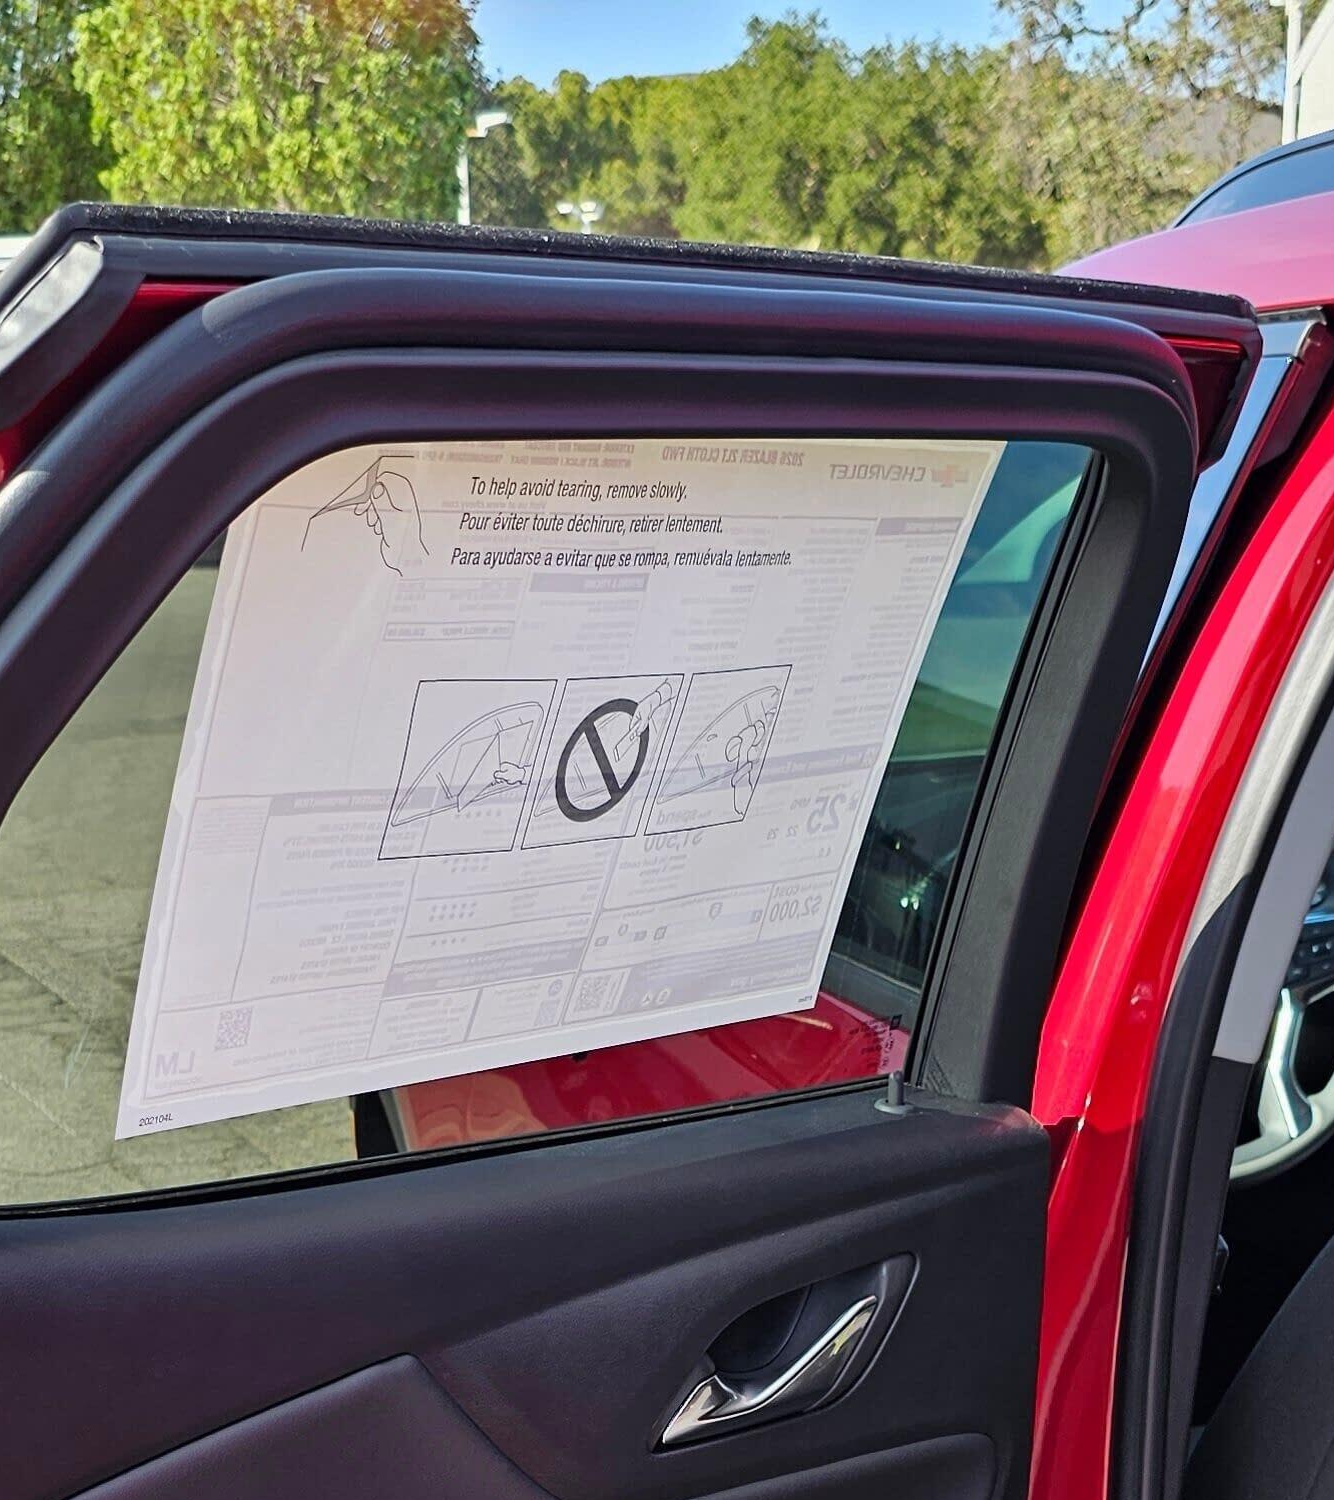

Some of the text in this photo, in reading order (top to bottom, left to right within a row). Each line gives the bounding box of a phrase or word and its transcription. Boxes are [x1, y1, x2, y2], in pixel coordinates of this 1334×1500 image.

[471, 476, 687, 502] To help avoid tearing, remove slowly.
[459, 512, 723, 535] Pour éviter toute déchirure, retirer lentement.
[451, 548, 792, 570] Para ayudarse a evitar que se rompa, remuévala lentamente.
